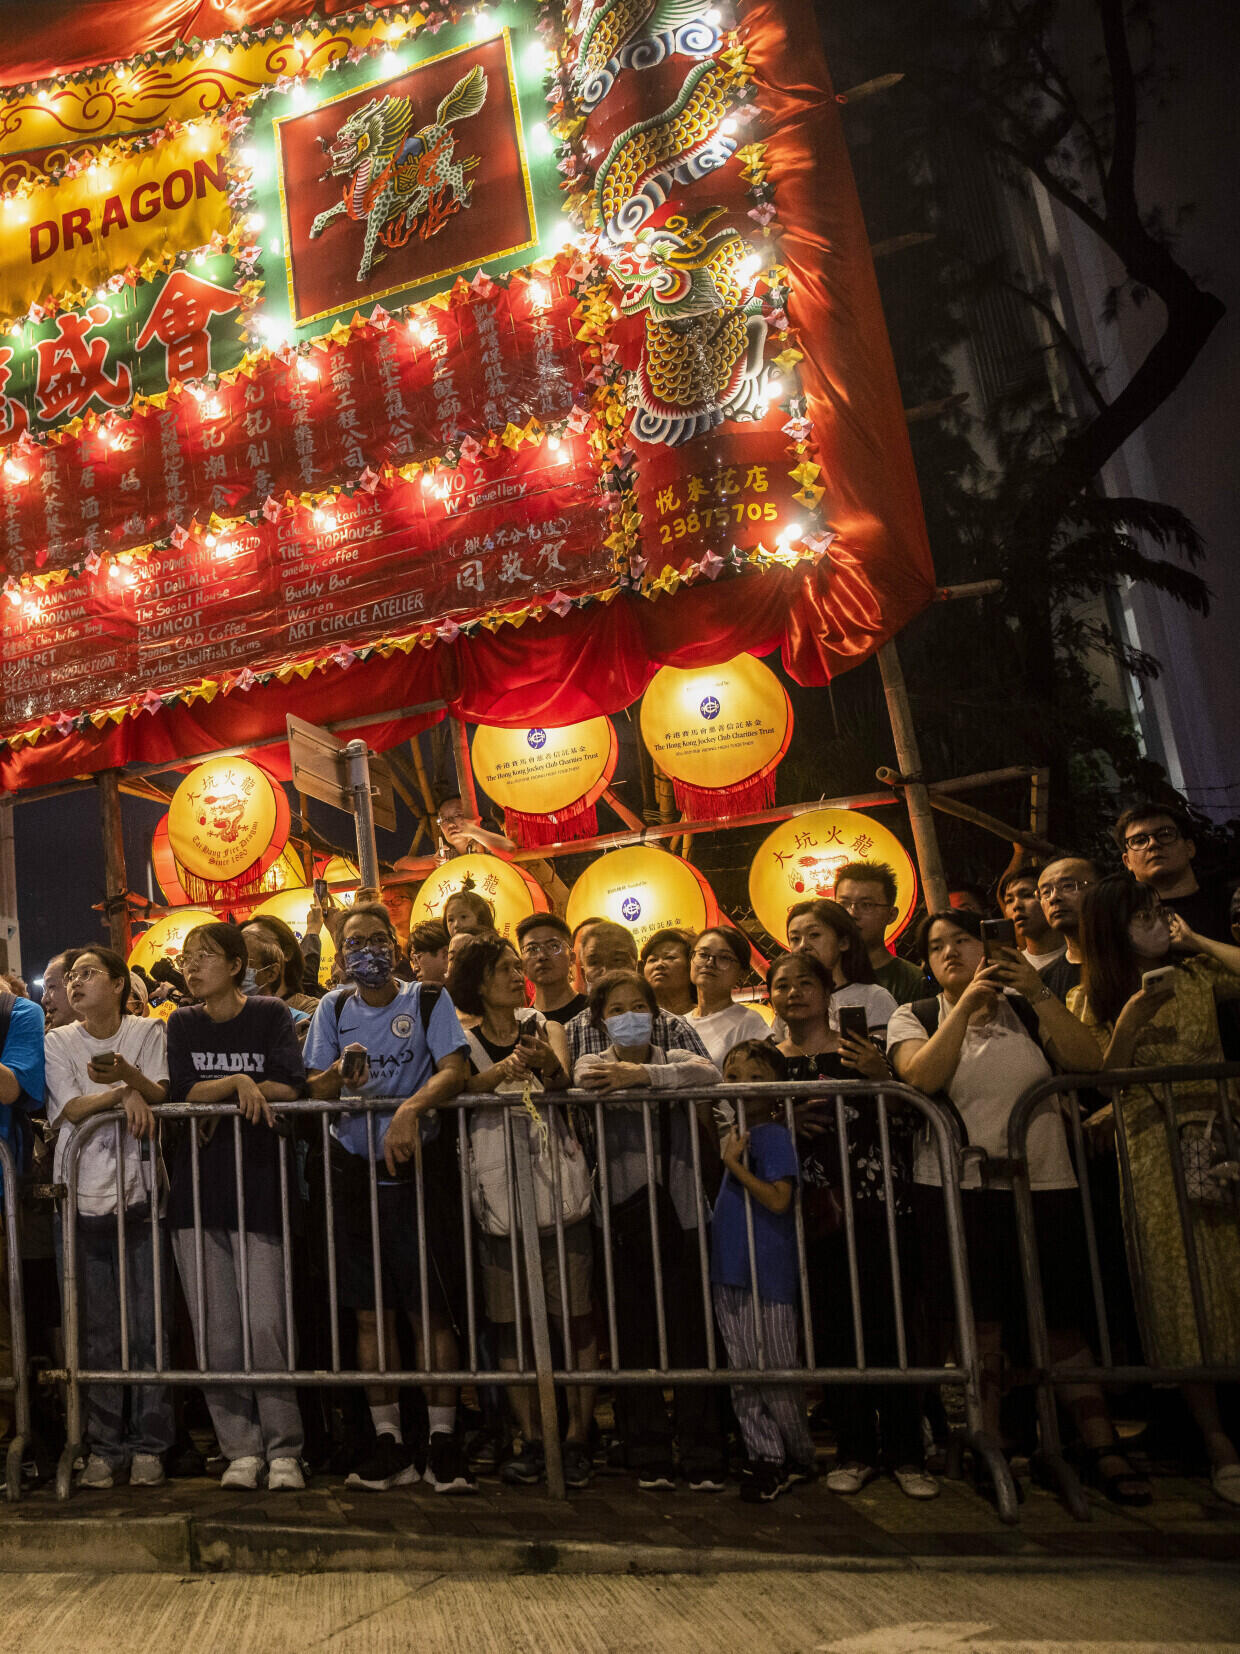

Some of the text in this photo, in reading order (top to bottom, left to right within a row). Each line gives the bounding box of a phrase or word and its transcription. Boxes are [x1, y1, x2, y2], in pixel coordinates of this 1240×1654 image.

[31, 152, 228, 264] DRAGON
[473, 467, 486, 484] 2
[444, 482, 528, 515] W Jewellery
[660, 502, 778, 545] 23875705
[279, 519, 383, 561] THE SHOPHOUSE
[131, 561, 161, 581] SHARP
[163, 553, 194, 574] POWER
[245, 536, 260, 550] LTD
[322, 549, 359, 567] coffee
[164, 577, 186, 594] Deli
[189, 568, 219, 586] Mart
[286, 574, 352, 602] Buddy Bar
[26, 606, 86, 630] KADOKAWA
[136, 588, 230, 622] The Social House
[288, 601, 333, 622] Warren
[289, 593, 424, 642] ART CIRCLE ATELIER
[138, 611, 203, 641] PLUMCOT
[175, 632, 205, 650] CAD
[209, 622, 247, 640] Coffee
[34, 649, 57, 666] PET
[50, 655, 116, 680] PRODUCTION
[138, 639, 261, 679] Taylor Shellfish Farms
[666, 741, 682, 750] Hong
[683, 740, 697, 748] Kong
[186, 769, 256, 807] 大坑火龍
[773, 824, 875, 869] 大坑火龍
[148, 927, 183, 954] 大坑
[190, 1051, 265, 1073] RIADLY
